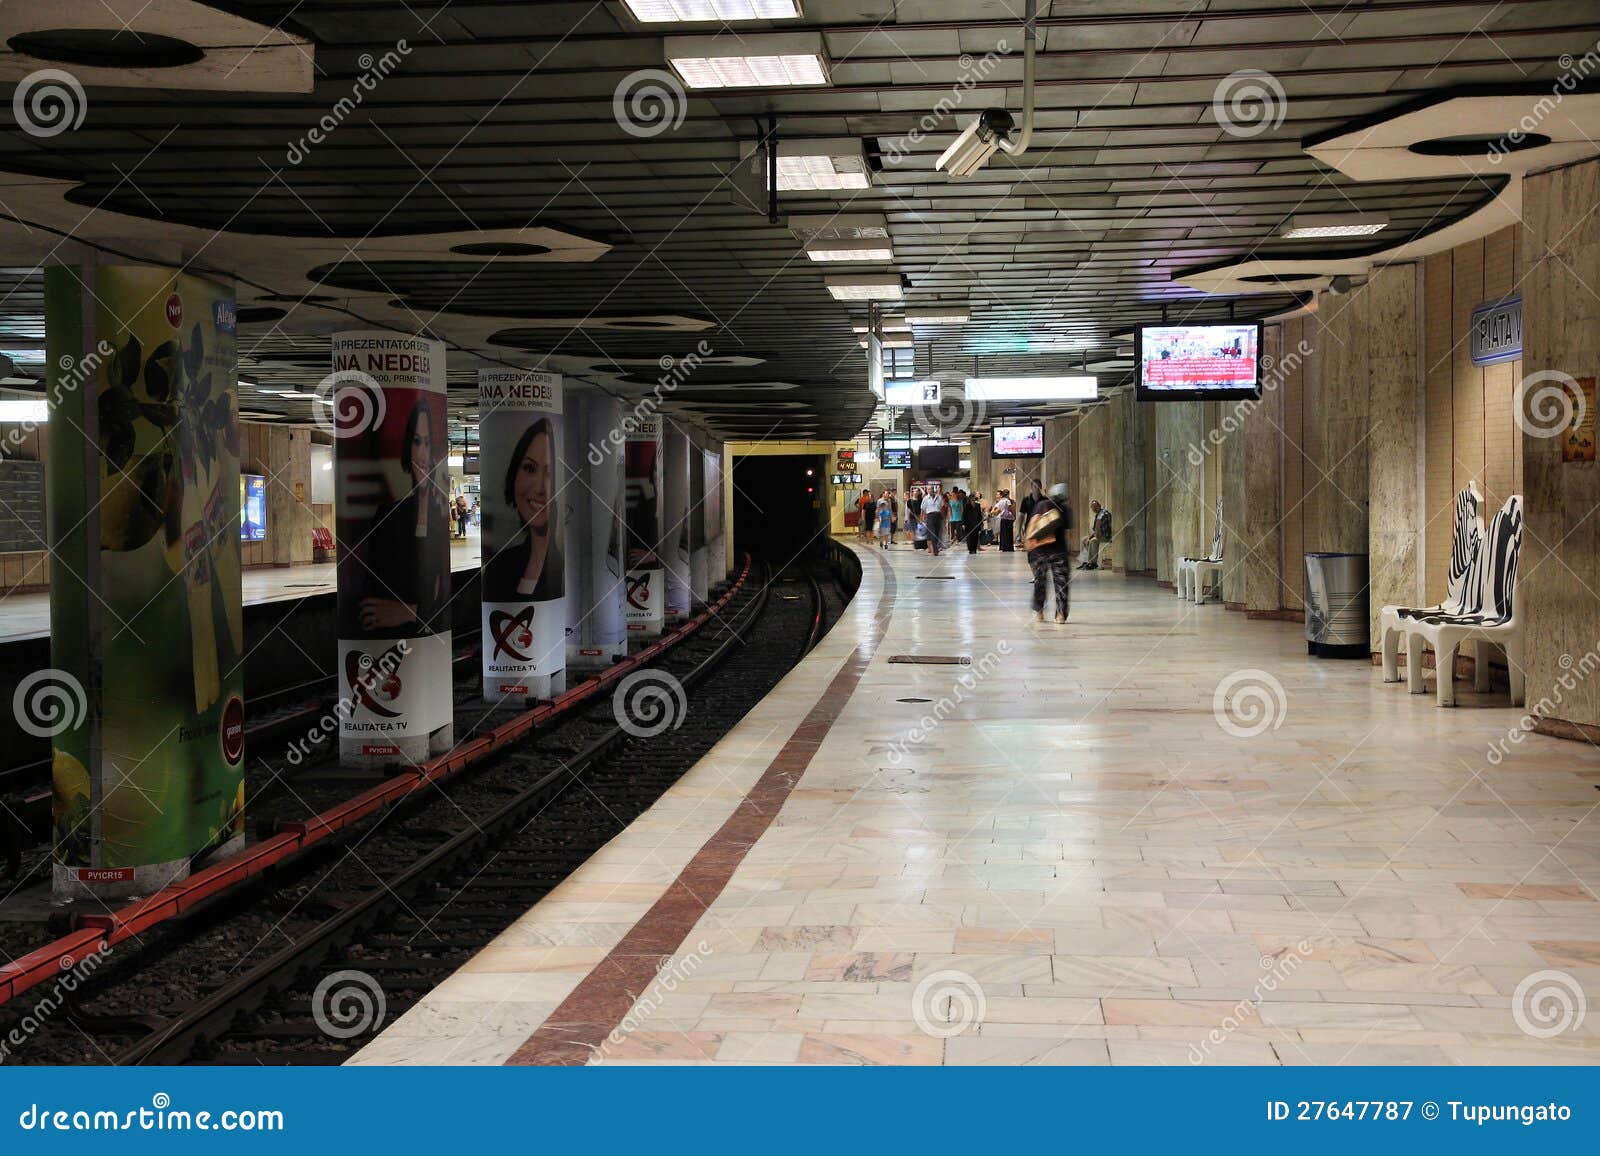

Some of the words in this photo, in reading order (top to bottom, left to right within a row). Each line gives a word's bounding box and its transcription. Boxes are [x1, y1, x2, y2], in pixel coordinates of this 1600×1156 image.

[1480, 311, 1513, 351] PIATA
[341, 338, 416, 351] PREZENTATOR
[393, 374, 417, 384] PRIME
[488, 373, 544, 383] PREZENTATOR
[488, 664, 527, 673] REALITATEA
[529, 664, 537, 672] TV
[344, 722, 393, 731] REALITATEA
[396, 721, 408, 731] TV
[87, 870, 124, 880] PV1CR15
